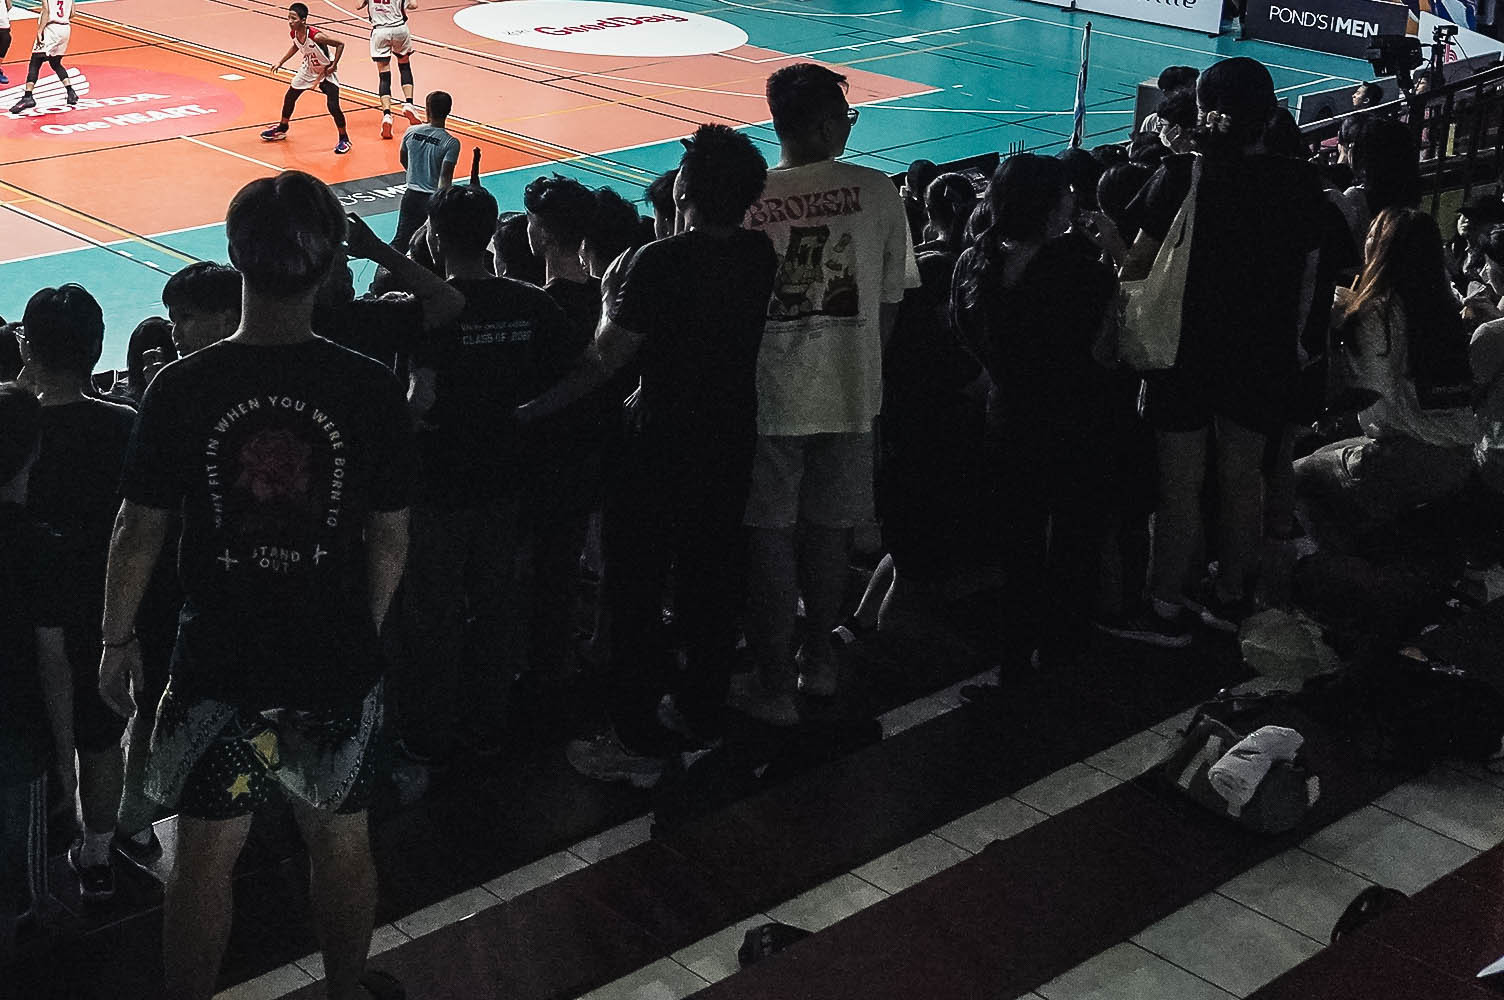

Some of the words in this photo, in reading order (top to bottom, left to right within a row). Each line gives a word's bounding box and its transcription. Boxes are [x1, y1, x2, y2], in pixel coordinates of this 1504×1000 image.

[56, 0, 64, 18] 3
[534, 16, 620, 36] Good
[615, 13, 688, 27] Day
[1270, 5, 1329, 28] POND'S
[1335, 16, 1379, 38] MEN
[40, 120, 105, 135] One
[268, 395, 306, 412] YOU
[214, 397, 260, 433] WHEN
[311, 408, 344, 451] WERE
[205, 437, 220, 456] IN
[206, 464, 220, 486] FIT
[330, 457, 346, 501] BORN
[326, 508, 339, 528] TO
[252, 545, 300, 563] STAND
[259, 557, 289, 574] OUT
